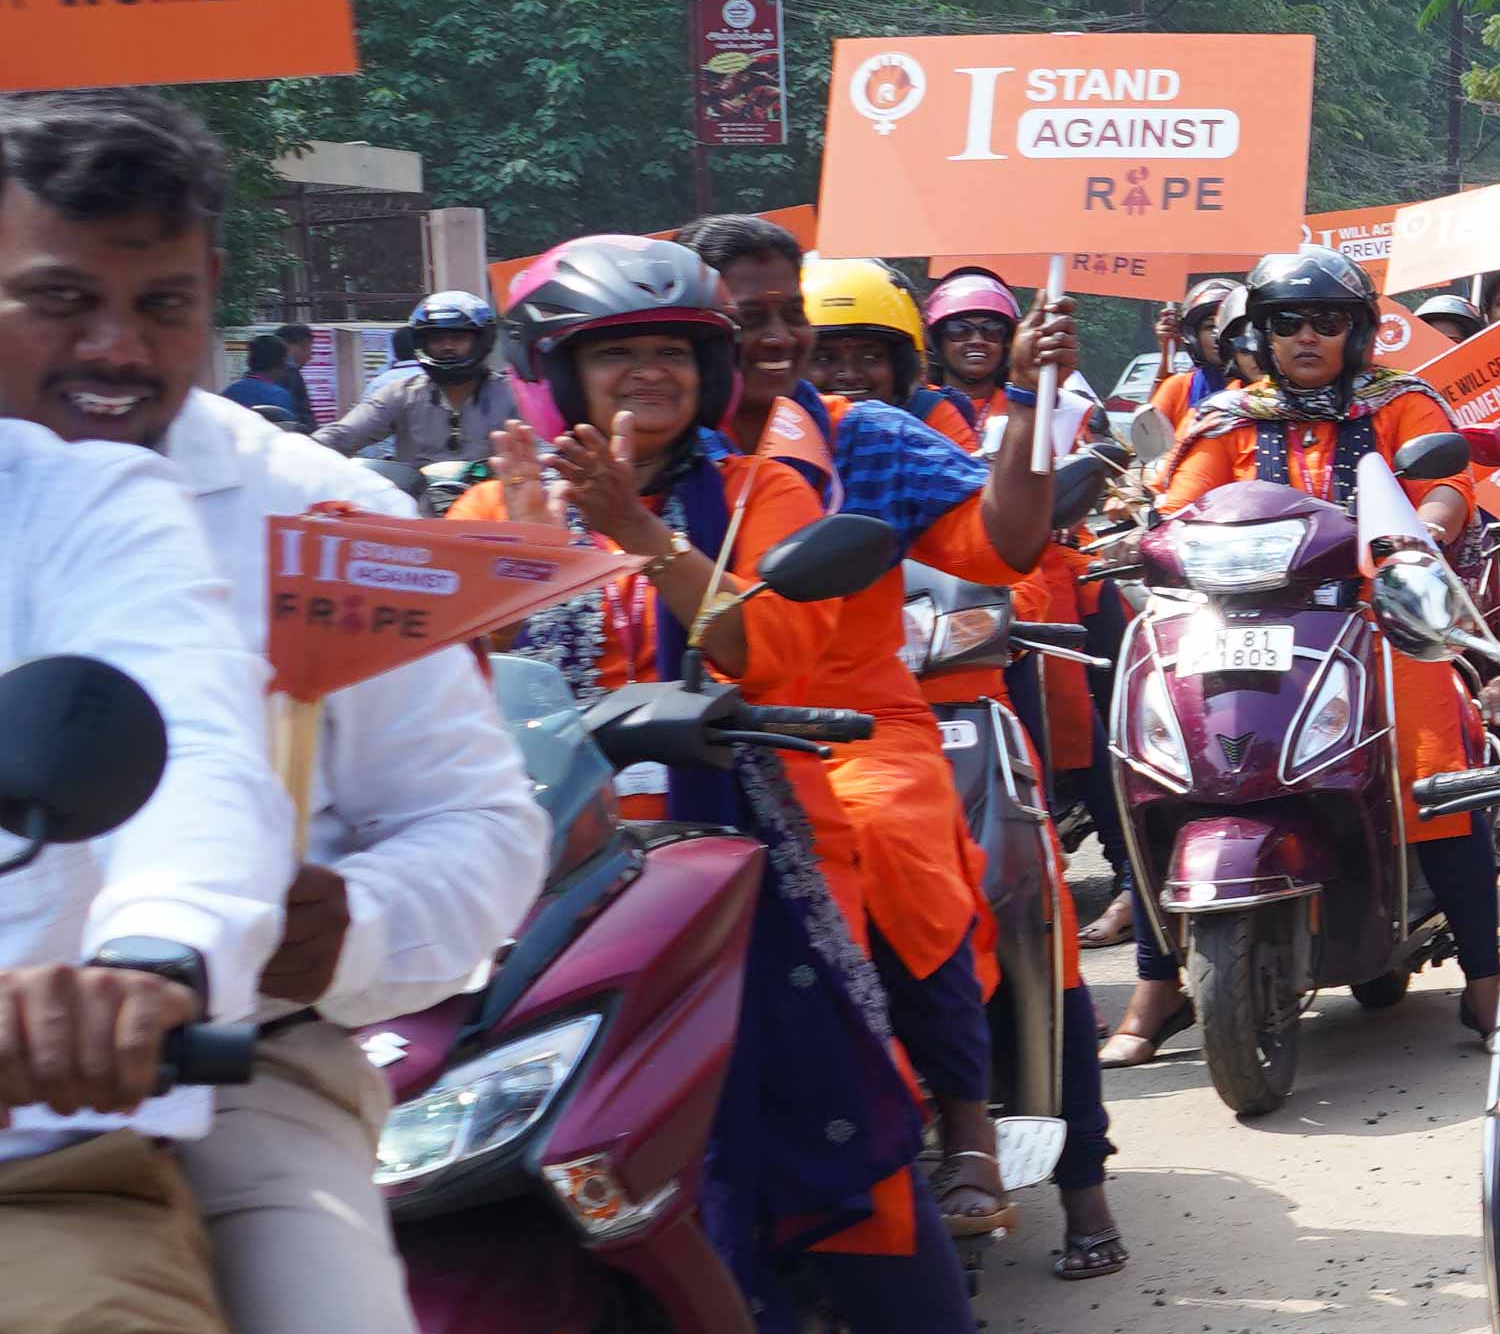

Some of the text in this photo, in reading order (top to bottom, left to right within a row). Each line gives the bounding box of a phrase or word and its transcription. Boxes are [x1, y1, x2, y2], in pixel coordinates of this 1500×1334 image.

[1025, 67, 1181, 102] STAND
[946, 66, 1016, 161] I
[1032, 118, 1225, 149] AGAINST
[1339, 225, 1369, 241] WILL
[1342, 241, 1390, 259] PREVE
[1456, 368, 1490, 396] WILL
[1243, 630, 1271, 651] 81
[1219, 649, 1278, 667] 1803
